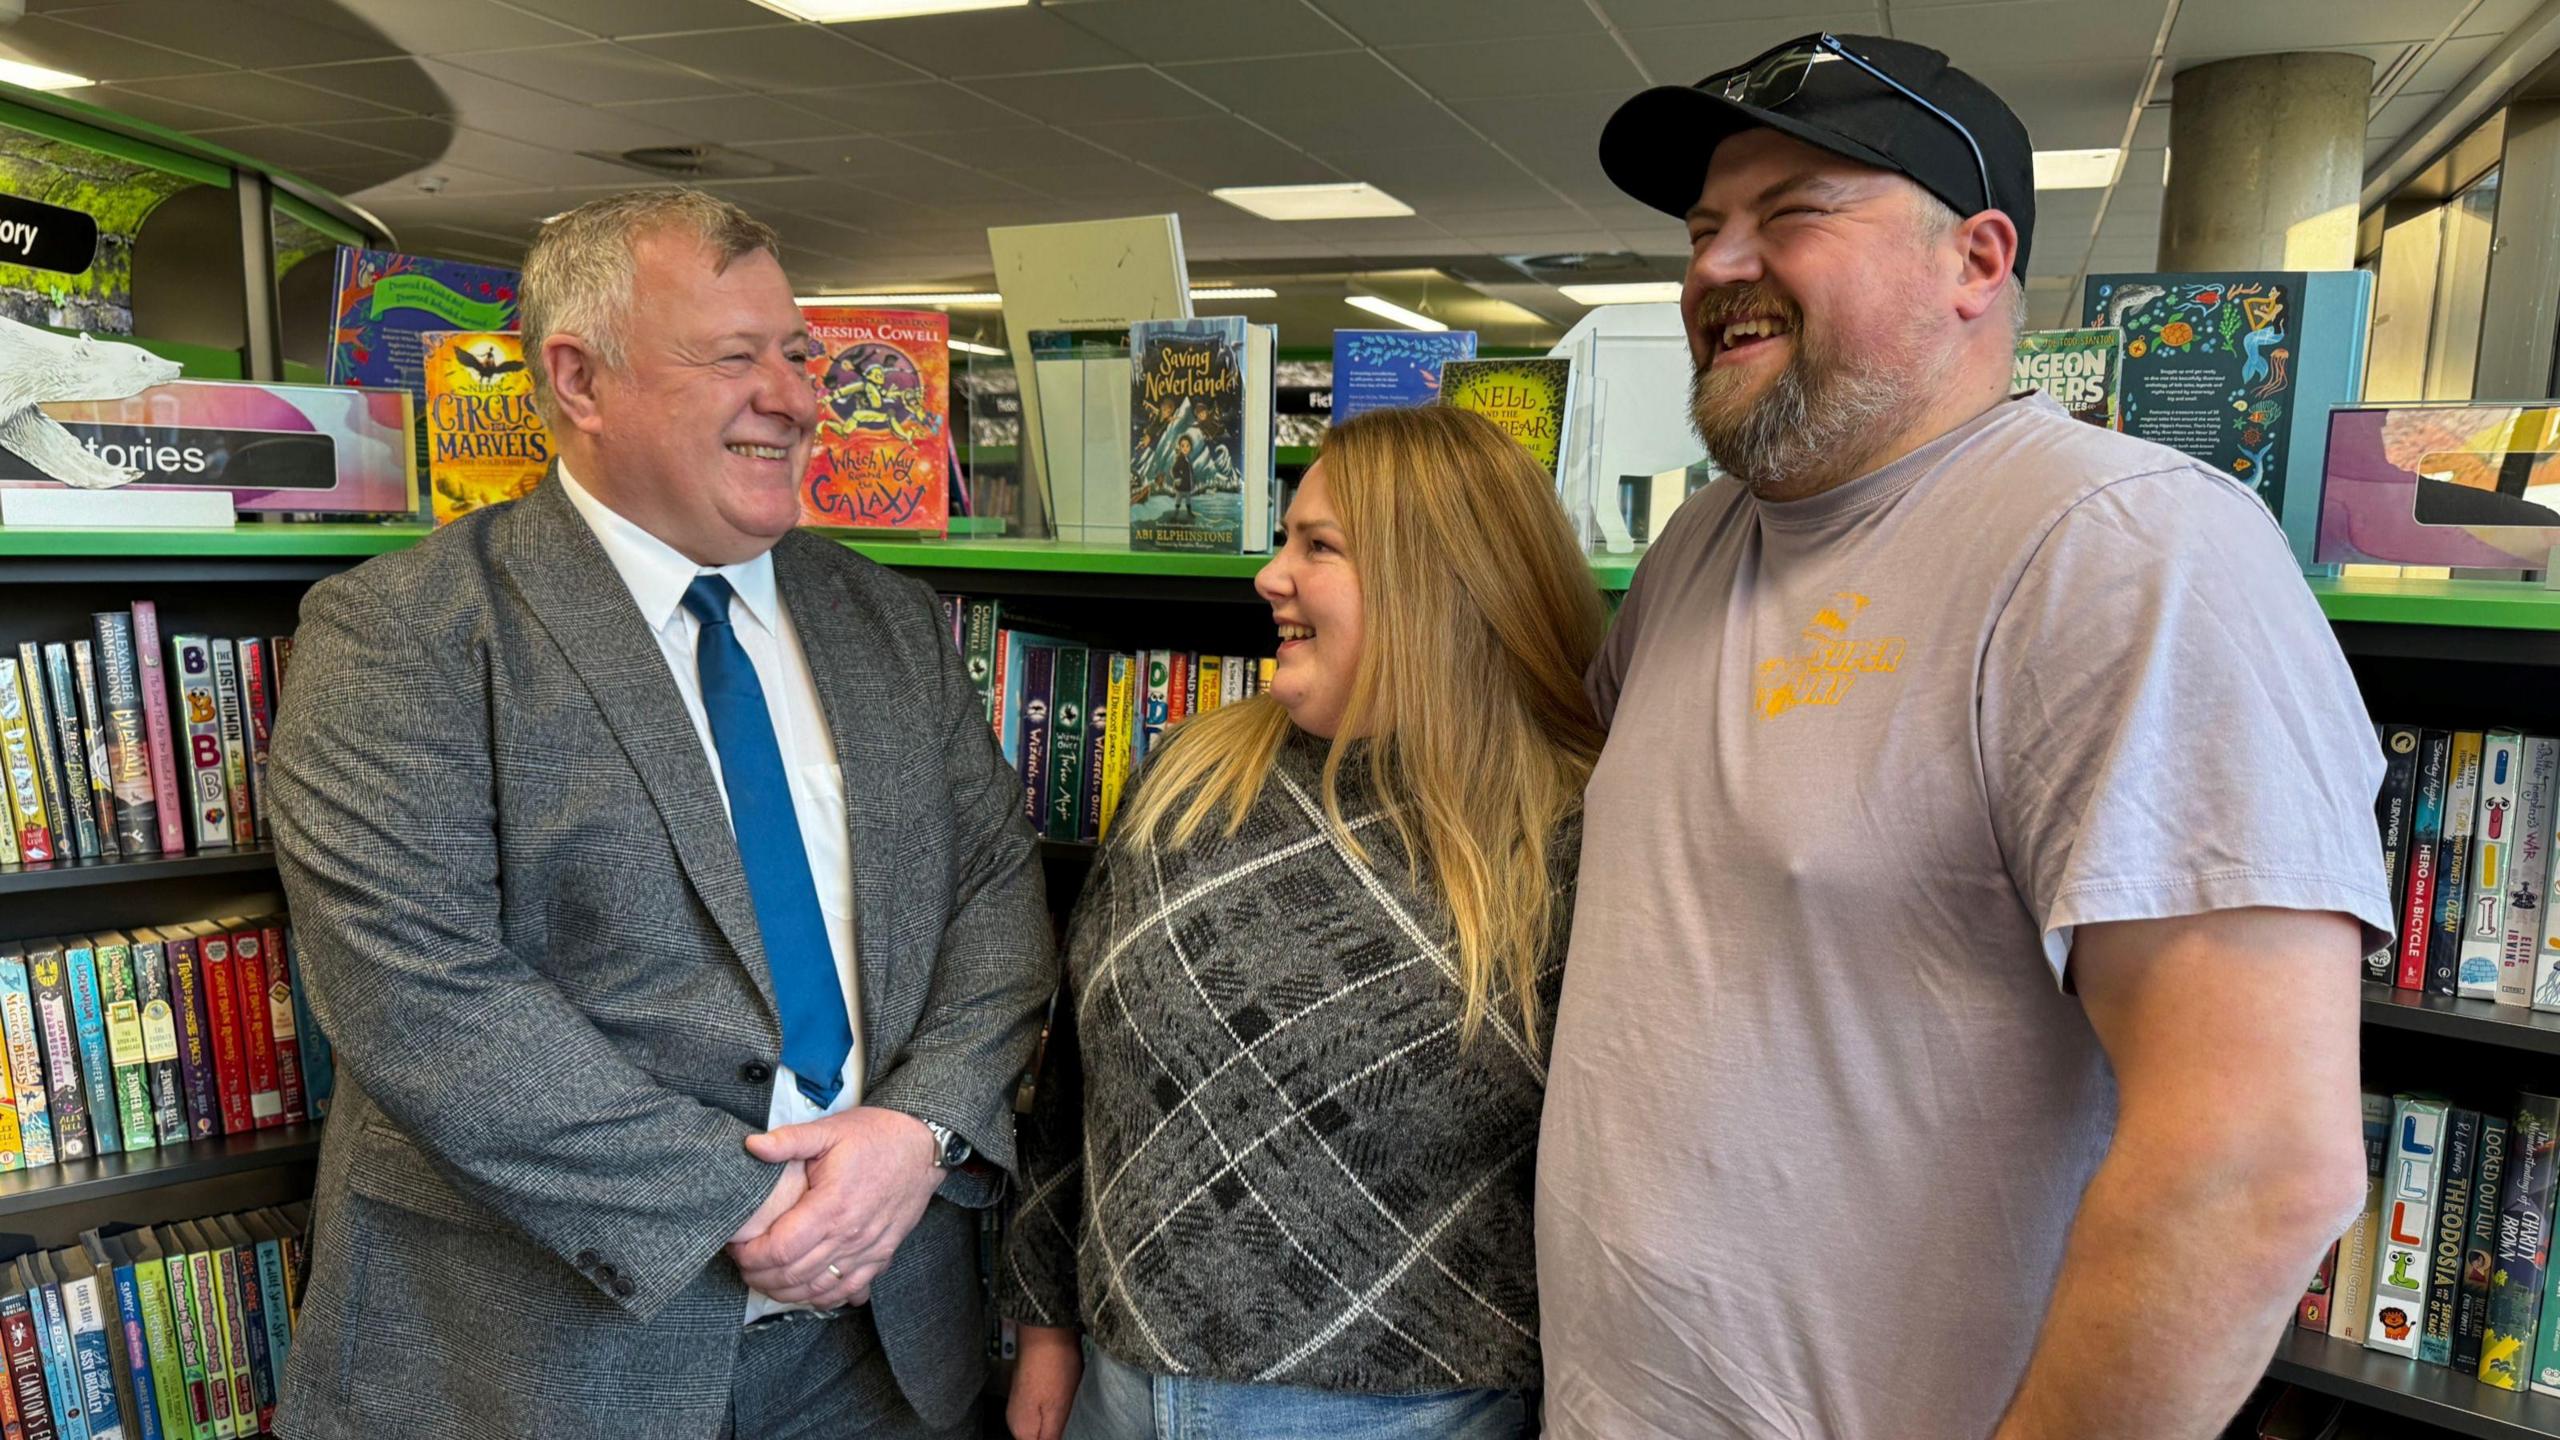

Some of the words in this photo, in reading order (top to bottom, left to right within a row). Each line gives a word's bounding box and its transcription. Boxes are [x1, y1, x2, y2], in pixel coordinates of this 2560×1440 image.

[0, 219, 39, 256] ory
[878, 324, 940, 342] COWELL
[1160, 347, 1211, 376] Saving
[1145, 372, 1228, 401] Neverland
[1472, 386, 1536, 410] NELL
[433, 393, 544, 432] CIRCUS
[84, 436, 206, 473] tories
[435, 433, 547, 464] MARVELS
[828, 447, 877, 472] Which
[882, 448, 914, 482] Way
[811, 474, 926, 526] GALAXY
[1136, 529, 1152, 540] ABI
[1156, 529, 1232, 543] ELPHINSTONE
[971, 605, 981, 651] COWELL
[981, 605, 991, 651] CRESSIDA
[100, 619, 123, 705] ARMSTRONG
[114, 623, 135, 700] ALEXANDER
[216, 651, 231, 661] THE
[219, 662, 234, 693] LAST
[1187, 664, 1196, 691] ROALD
[221, 696, 240, 741] HUMAN
[1027, 727, 1042, 778] Wizards
[1060, 752, 1077, 784] Twice
[1091, 735, 1105, 786] Wizards
[2426, 740, 2444, 777] Shirley
[2455, 750, 2467, 789] HUMPHREYS
[2467, 753, 2477, 787] ALASTAIR
[1055, 786, 1071, 821] Magic
[2422, 780, 2442, 811] Hughes
[2387, 798, 2401, 847] SURVIVORS
[2454, 812, 2469, 835] GIRL
[2453, 836, 2463, 854] WHO
[2522, 831, 2541, 863] WAR
[2418, 845, 2431, 879] HERO
[2450, 855, 2462, 885] ROWED
[2416, 880, 2425, 896] ON
[2408, 906, 2423, 957] BICYCLE
[2444, 899, 2458, 933] OCEAN
[2504, 929, 2520, 968] IRVING
[2518, 936, 2533, 965] ELLIE
[214, 969, 228, 997] GREAT
[245, 964, 259, 993] GREAT
[177, 960, 193, 989] TRAIN
[189, 1037, 202, 1066] PLACES
[219, 998, 230, 1025] BRAIN
[249, 994, 261, 1020] BRAIN
[5, 993, 21, 1043] MAGICAL
[13, 1044, 29, 1085] BEASTS
[20, 1005, 35, 1050] GLORIOUS
[43, 1003, 60, 1059] STARDUST
[52, 1060, 65, 1084] CITY
[56, 1019, 68, 1057] EXPLORERS
[27, 1051, 38, 1075] RACE
[88, 1041, 102, 1082] JENNIFER
[281, 1049, 295, 1085] JENNIFER
[94, 1084, 105, 1103] BELL
[126, 1072, 142, 1110] JENNIFER
[159, 1068, 175, 1106] JENNIFER
[286, 1088, 299, 1105] BELL
[59, 1115, 83, 1125] ALEX
[166, 1108, 178, 1128] BELL
[198, 1094, 208, 1114] BELL
[61, 1121, 83, 1131] BELL
[132, 1111, 145, 1131] BELL
[2483, 1125, 2506, 1180] LOCKED
[2536, 1130, 2549, 1147] The
[2518, 1121, 2539, 1194] Misunderstandings
[2478, 1183, 2496, 1211] OUT
[2519, 1194, 2531, 1206] of
[2351, 1211, 2369, 1272] Beautiful
[2434, 1178, 2468, 1285] THEODOSIA
[2475, 1213, 2495, 1241] LILY
[2498, 1215, 2517, 1262] BROWN
[2518, 1211, 2540, 1264] CHARITY
[76, 1285, 89, 1304] CARYS
[120, 1281, 134, 1312] SAMMY
[142, 1280, 158, 1313] HOLLY
[2344, 1274, 2361, 1316] Game
[2431, 1300, 2441, 1311] OF
[2473, 1298, 2485, 1317] NICK
[45, 1290, 61, 1324] LEONORA
[53, 1326, 67, 1358] BOLT
[80, 1305, 92, 1324] BRAY
[2426, 1313, 2439, 1337] CHAOS
[2438, 1303, 2452, 1341] SERPENTS
[2470, 1318, 2482, 1339] LAKE
[149, 1315, 166, 1362] HOPKINSON
[13, 1347, 36, 1371] THE
[79, 1349, 94, 1371] ISSY
[93, 1351, 104, 1365] A
[82, 1373, 102, 1414] BRADLEY
[96, 1369, 111, 1389] Song
[18, 1372, 47, 1428] CANYON'S
[100, 1391, 115, 1405] for
[138, 1377, 147, 1404] CHARLIE
[143, 1410, 154, 1435] BROOKS
